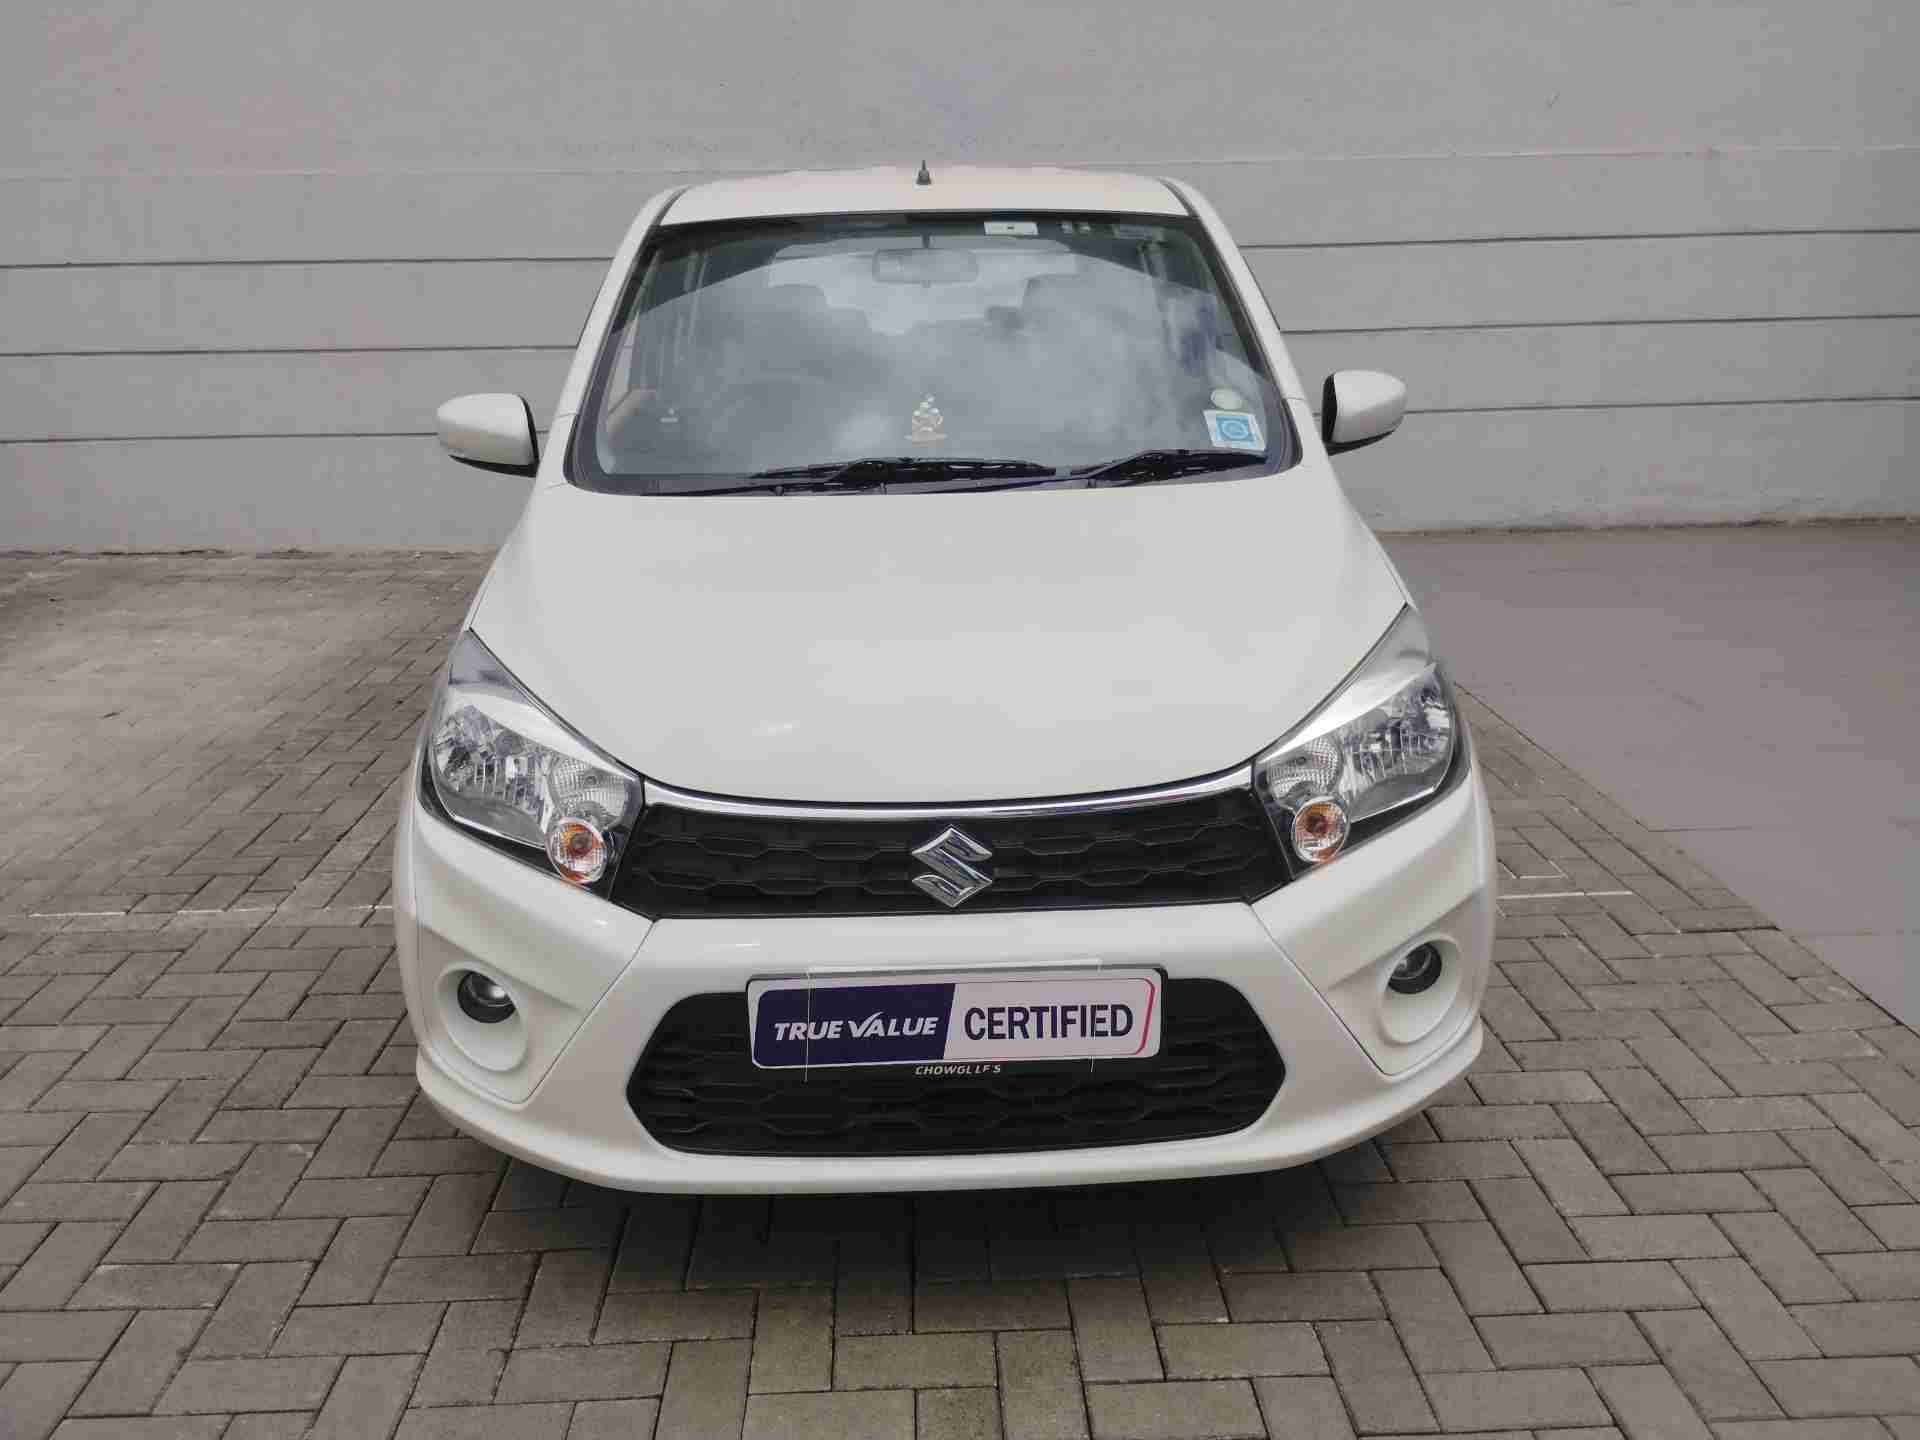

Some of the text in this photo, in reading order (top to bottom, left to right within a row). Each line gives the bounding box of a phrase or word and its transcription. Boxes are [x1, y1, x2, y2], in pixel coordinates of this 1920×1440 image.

[773, 1012, 938, 1042] TRUE VALUE
[964, 1004, 1133, 1041] CERTIFIED
